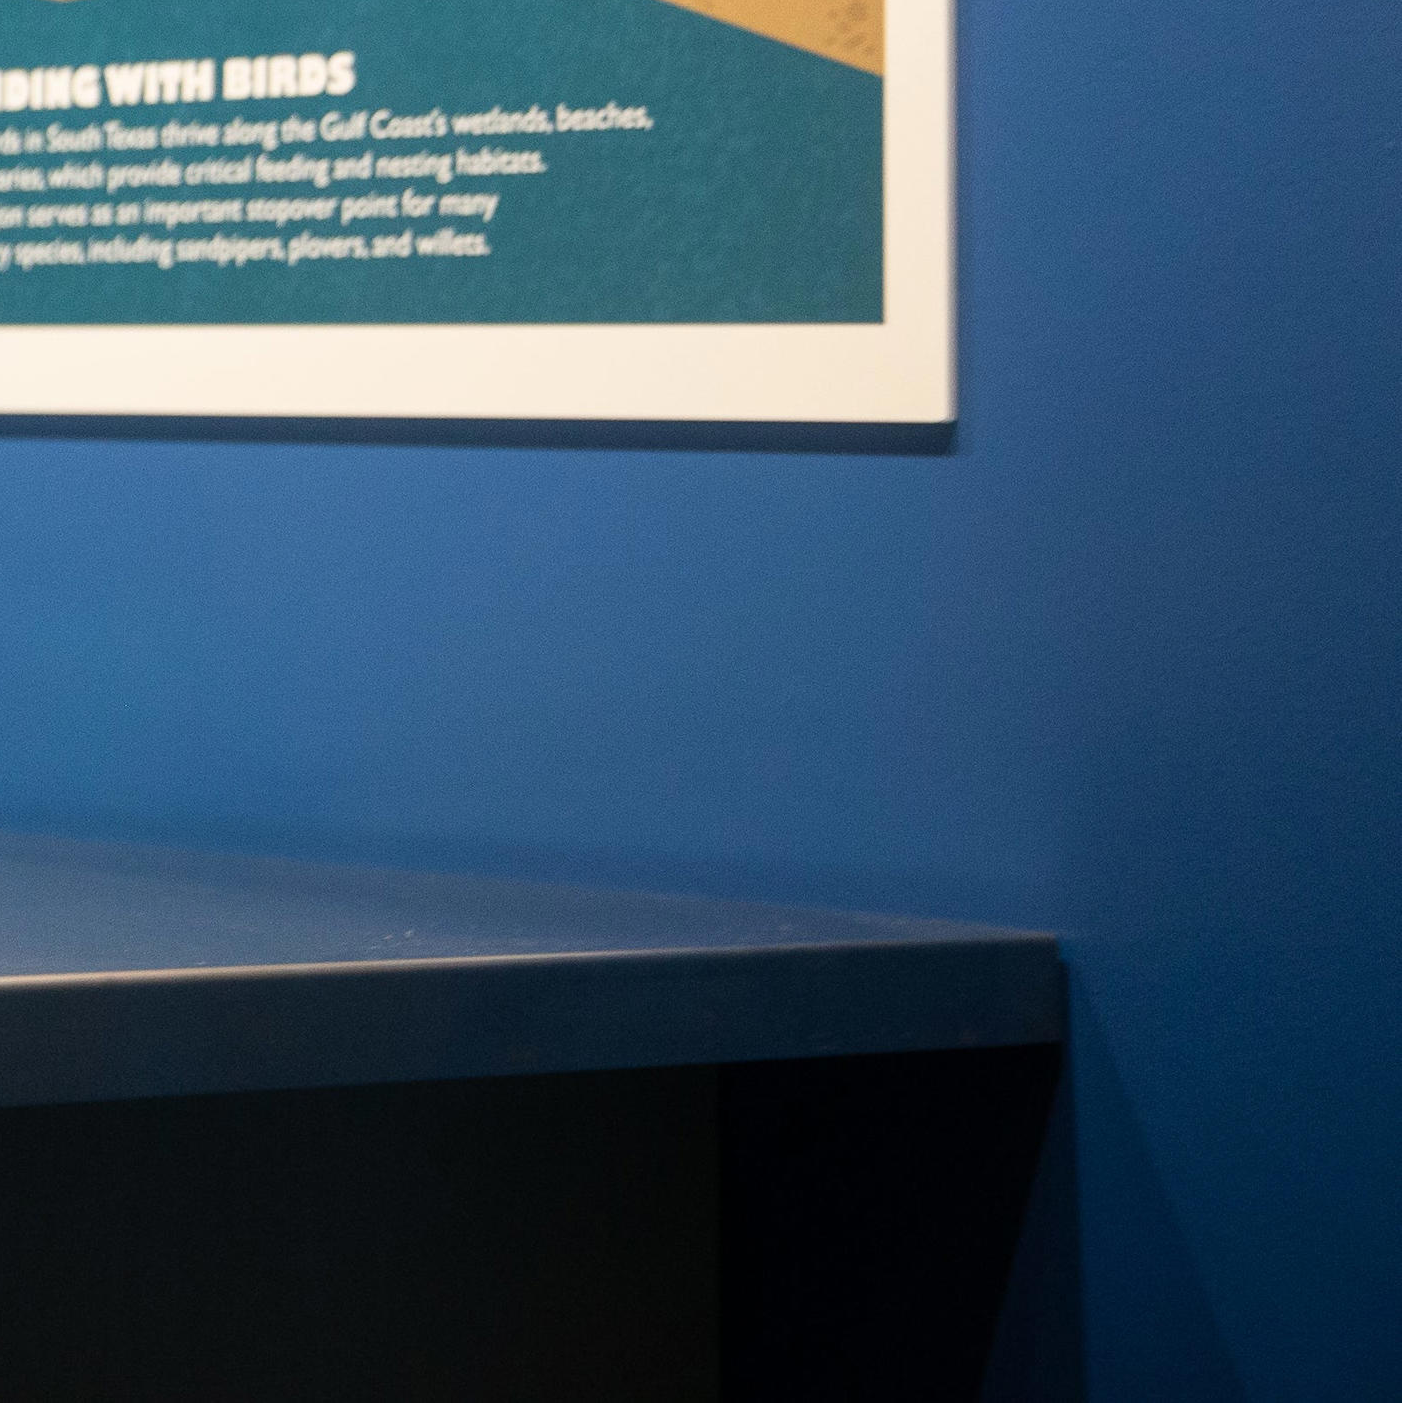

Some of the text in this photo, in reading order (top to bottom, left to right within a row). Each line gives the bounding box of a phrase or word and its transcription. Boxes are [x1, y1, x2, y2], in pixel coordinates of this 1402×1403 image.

[104, 58, 215, 106] WITH
[222, 51, 356, 100] BIRDS
[24, 127, 44, 153] in
[46, 122, 101, 153] South
[104, 120, 157, 150] Texas
[161, 119, 220, 148] thrive
[221, 117, 278, 151] along
[280, 114, 316, 144] the
[319, 110, 368, 141] Gulf
[556, 101, 654, 132] beaches,
[47, 161, 105, 189] which
[106, 157, 182, 194] provide
[184, 155, 253, 185] critical
[256, 153, 331, 188] feeding
[332, 151, 374, 180] and
[375, 150, 453, 184] nesting
[27, 204, 88, 228] serves
[91, 203, 114, 226] as
[115, 201, 141, 226] an
[144, 198, 244, 230] important
[245, 198, 339, 229] stopover
[341, 193, 398, 226] point
[401, 187, 436, 217] for
[439, 193, 500, 223] many
[88, 233, 174, 269] including
[371, 229, 413, 257] and
